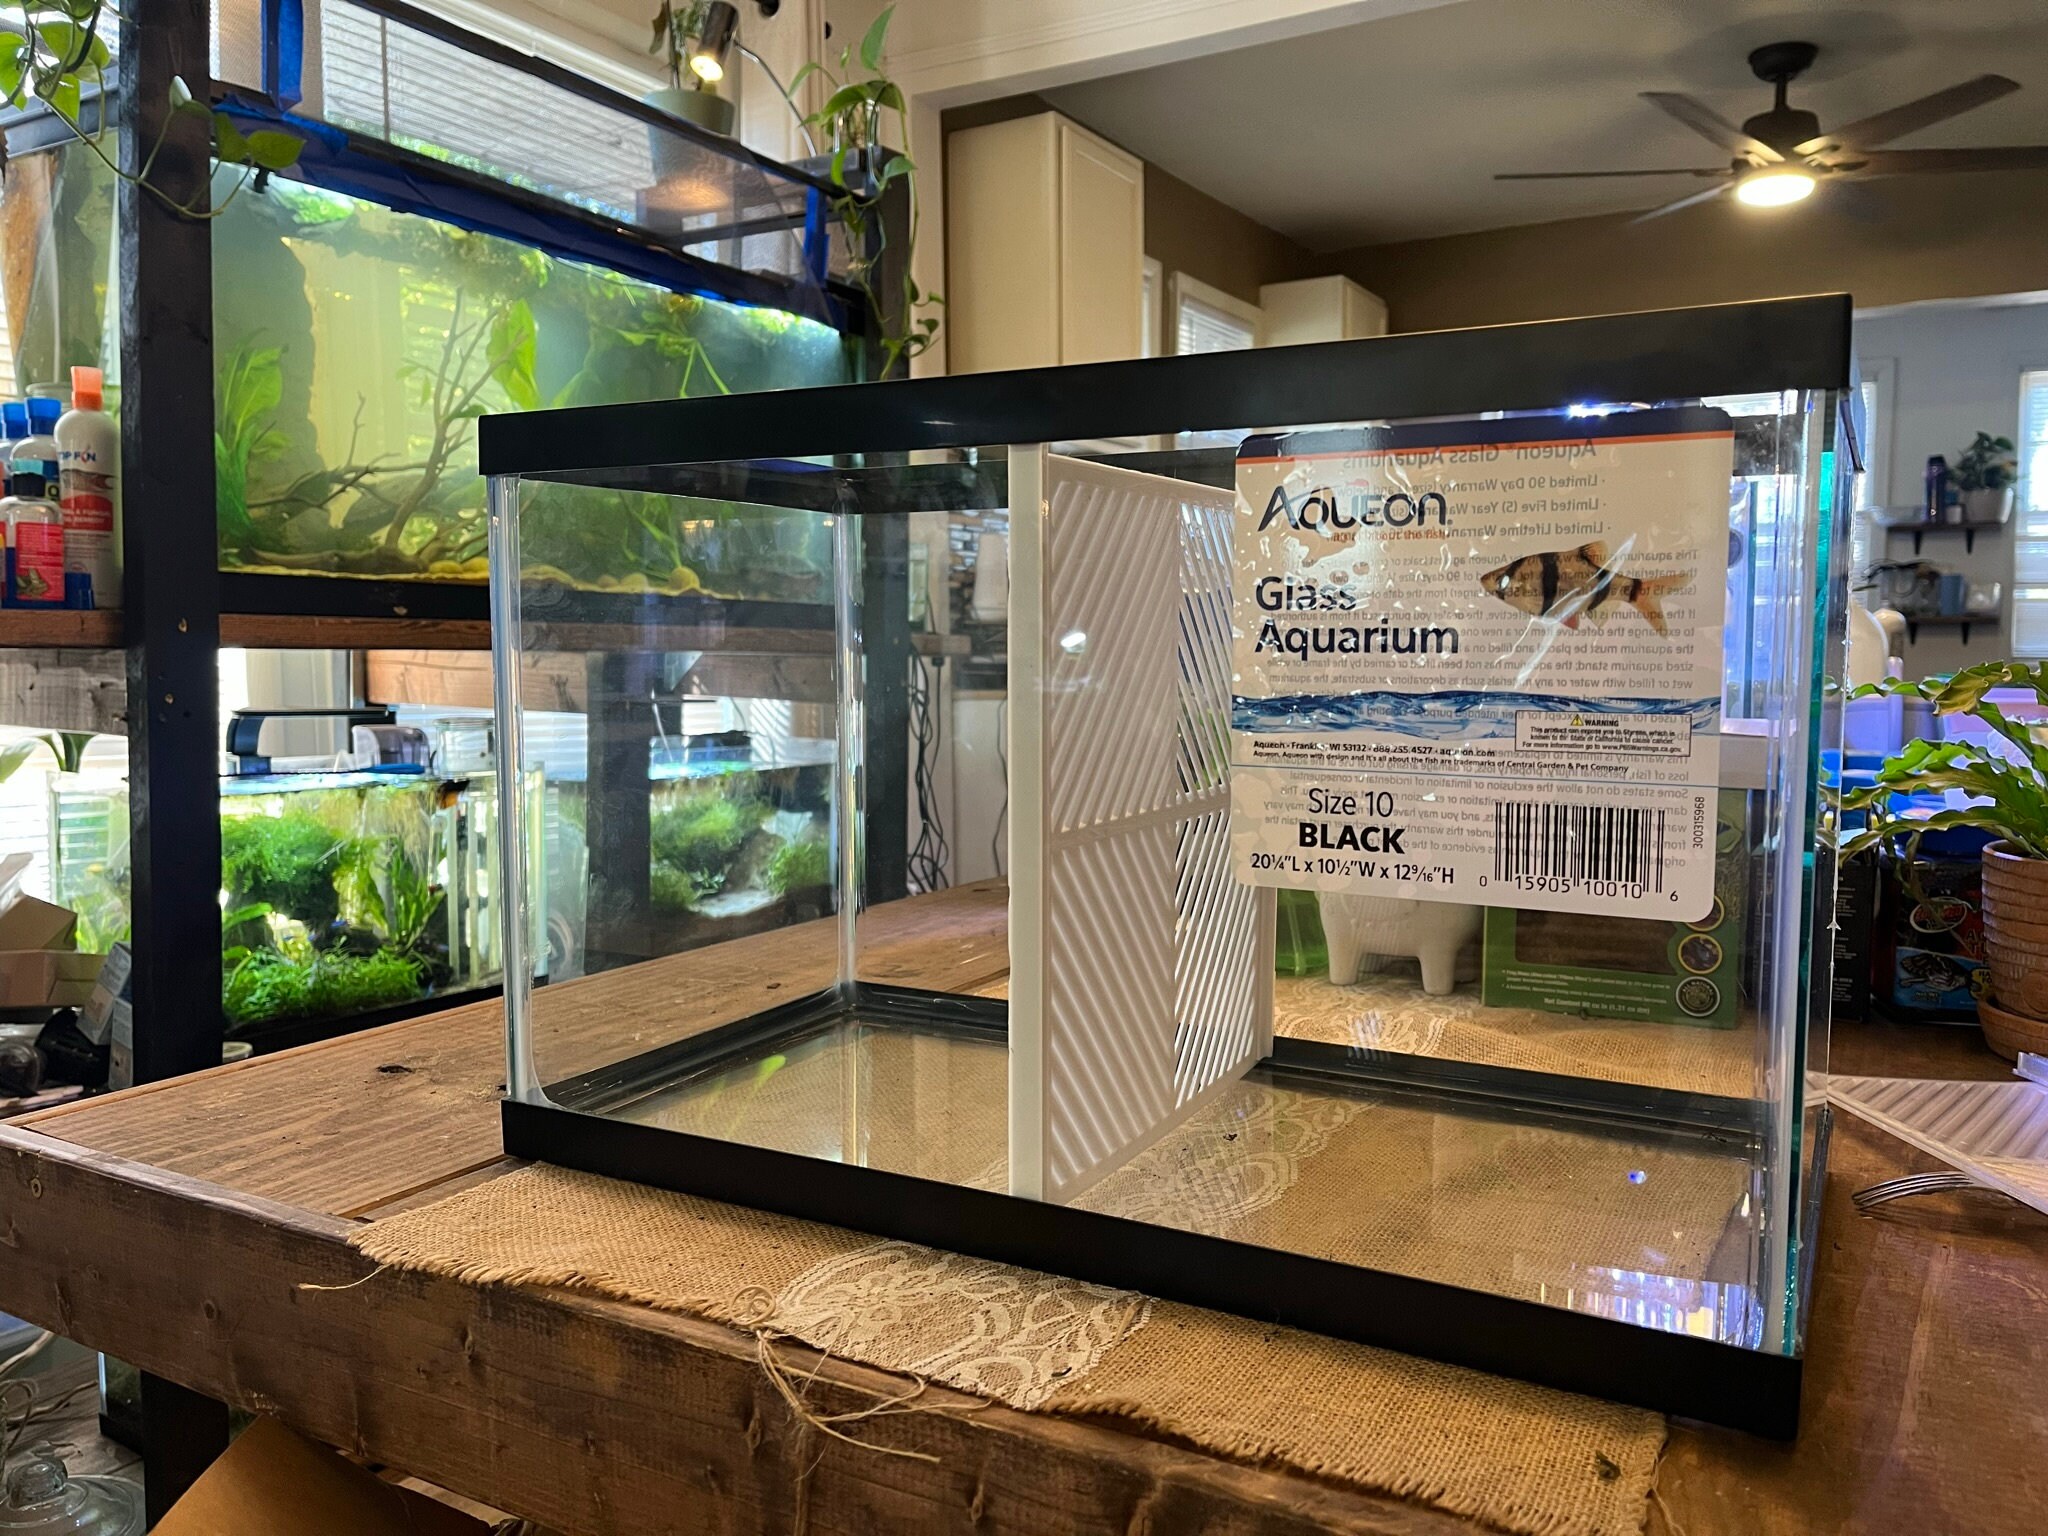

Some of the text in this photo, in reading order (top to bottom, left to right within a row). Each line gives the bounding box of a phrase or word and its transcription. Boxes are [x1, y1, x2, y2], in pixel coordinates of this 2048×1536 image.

[1256, 576, 1356, 611] Glass
[1255, 618, 1459, 661] Aquarium
[1253, 741, 1285, 752] Aqueon
[1292, 742, 1328, 752] Frankl,
[1330, 743, 1341, 751] WI
[1343, 743, 1366, 752] 53132
[1440, 748, 1495, 757] aquon.com
[1282, 752, 1308, 761] Aqueon
[1326, 754, 1348, 762] design
[1425, 757, 1438, 765] fish
[1454, 759, 1495, 767] trademarks
[1507, 760, 1535, 769] Central
[1537, 761, 1566, 770] Garden
[1590, 763, 1629, 774] Company
[1309, 788, 1356, 816] Size
[1365, 791, 1394, 818] 10
[1693, 797, 1705, 848] 300315968
[1299, 822, 1405, 854] BLACK
[1304, 860, 1313, 873] x
[1380, 865, 1389, 879] x
[1479, 876, 1679, 902] 0 15905 10010 6
